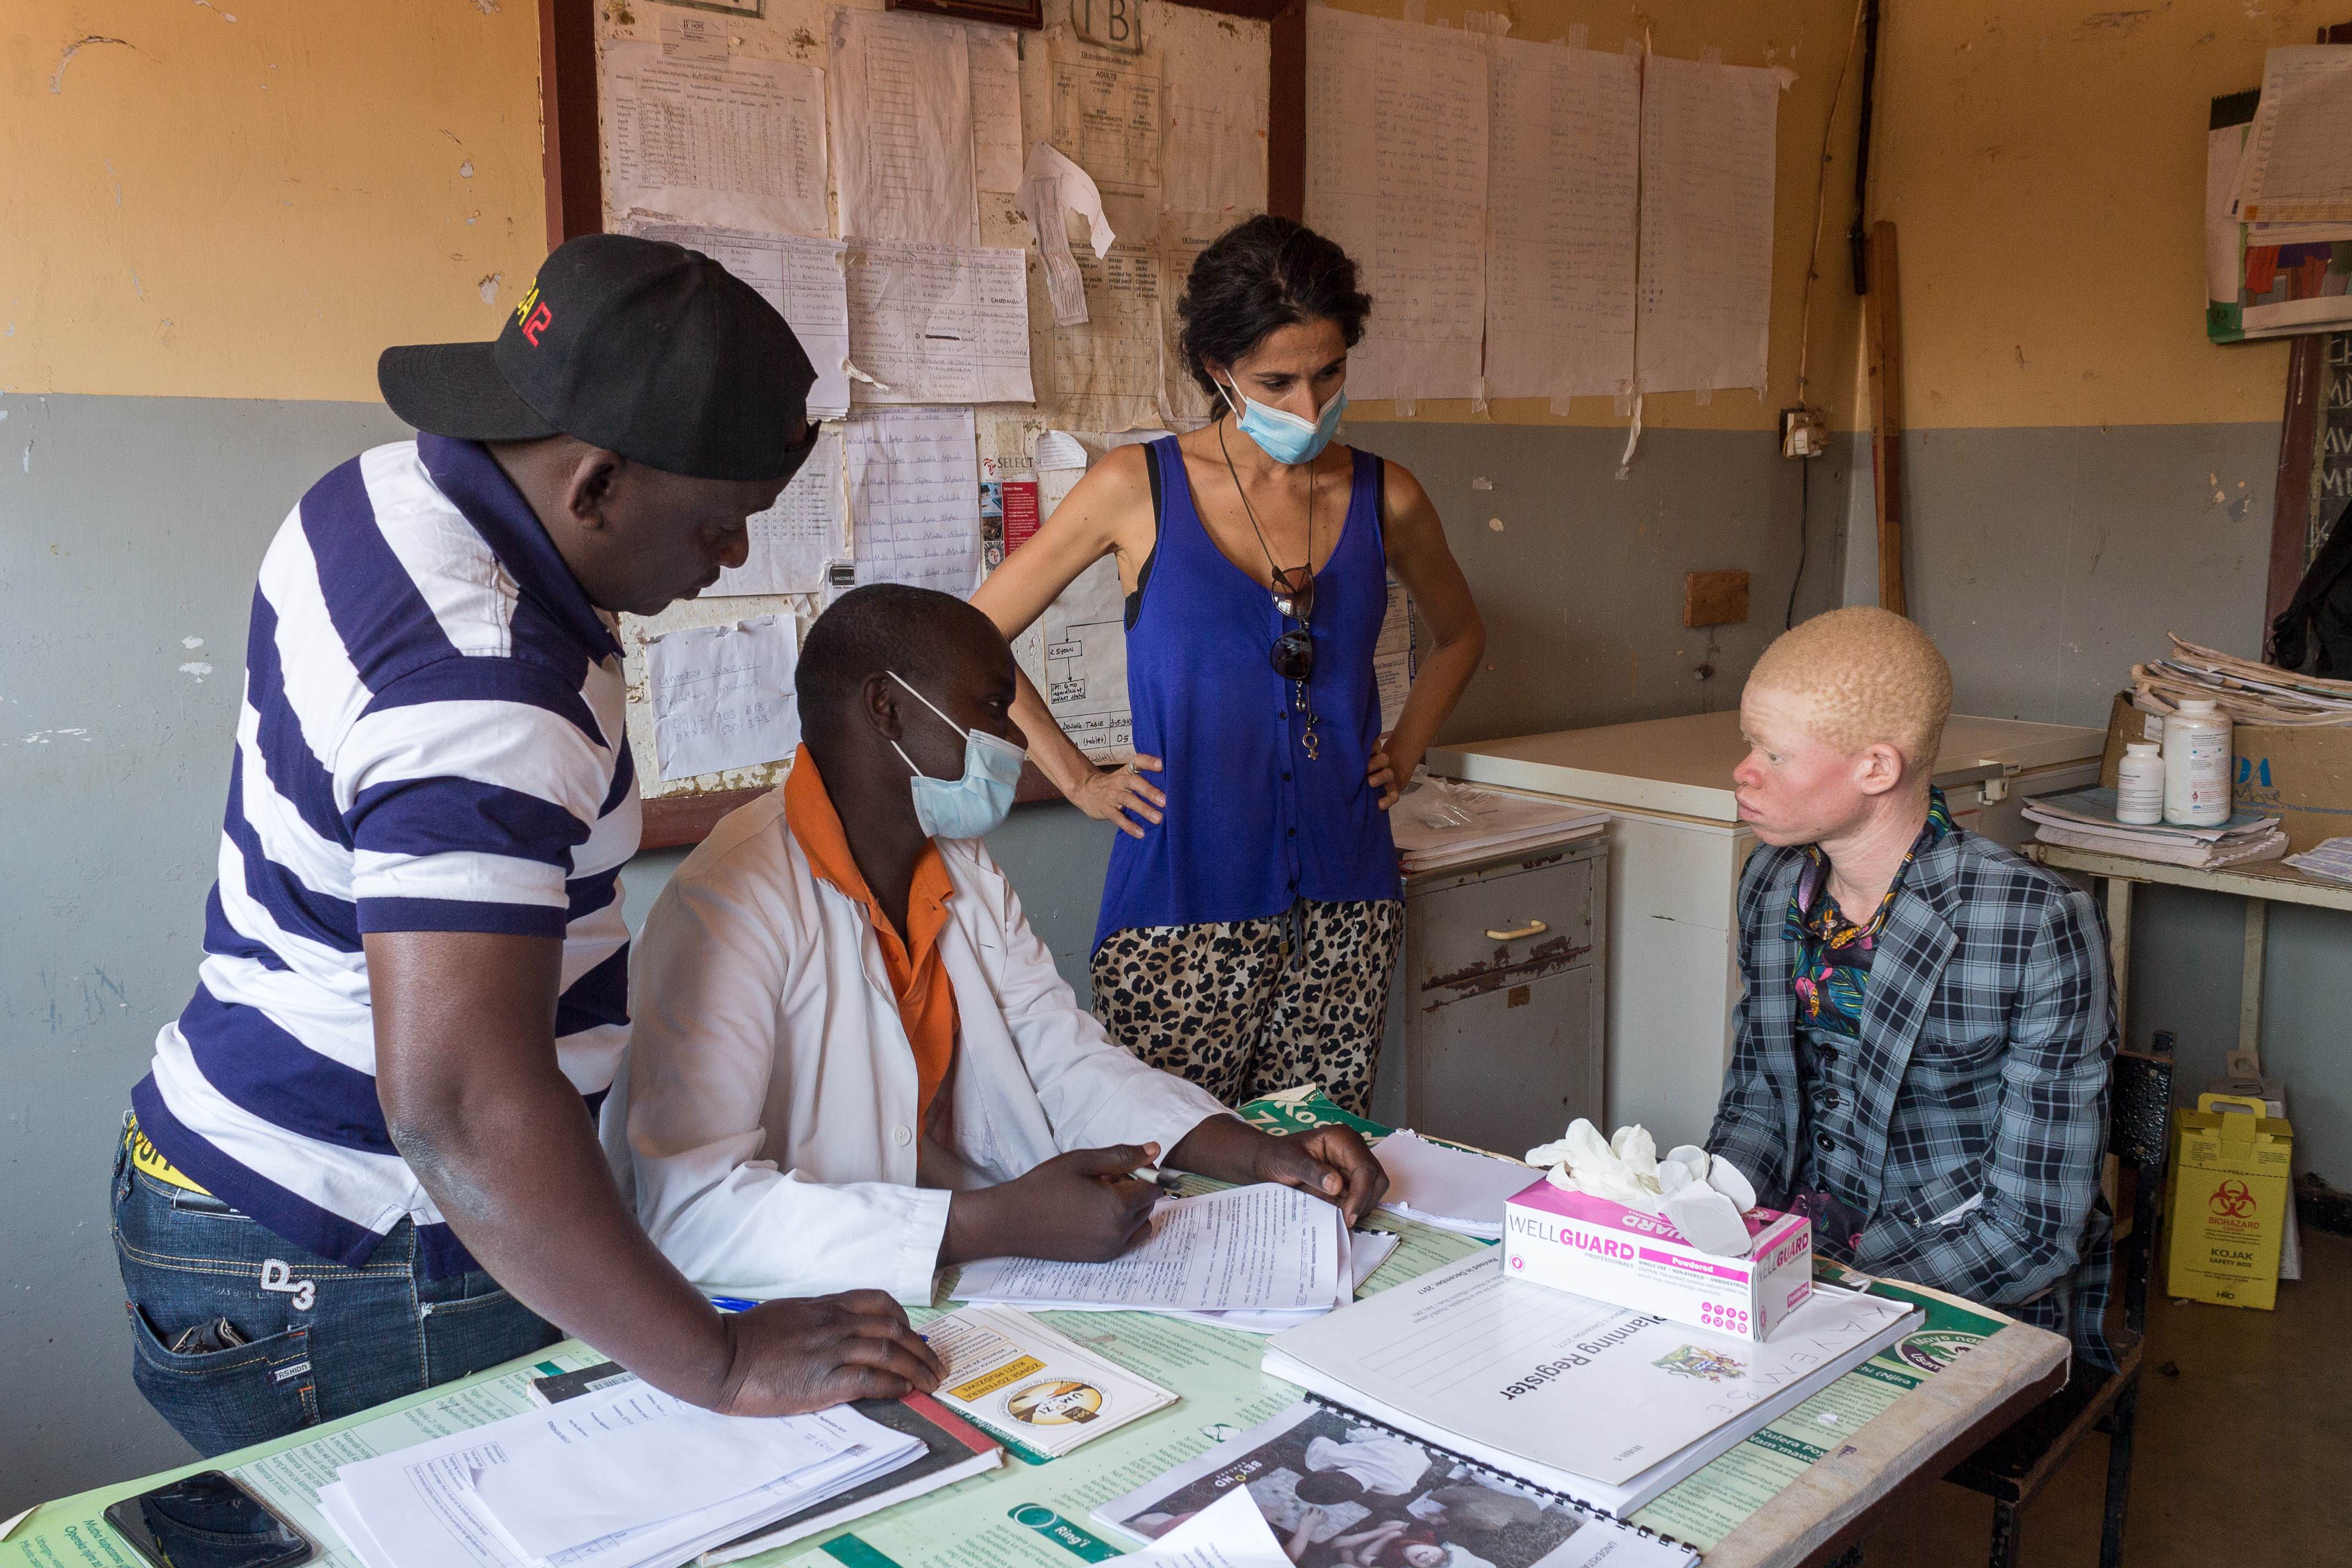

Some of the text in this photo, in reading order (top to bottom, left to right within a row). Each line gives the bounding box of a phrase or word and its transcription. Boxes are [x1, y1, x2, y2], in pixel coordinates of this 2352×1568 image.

[1096, 72, 1117, 80] ADULTS
[997, 456, 1033, 470] SELECT
[1063, 721, 1104, 731] DOSING TABLE
[1083, 733, 1107, 745] (tablet)
[2208, 1217, 2260, 1230] BIOHAZARD
[1510, 1214, 1635, 1261] WELLGUARD
[1585, 1252, 1635, 1268] PROFESSIONALS
[2211, 1248, 2253, 1260] KOJAK
[1639, 1260, 1654, 1270] SINGLE
[1672, 1257, 1713, 1273] Powdered
[1434, 1268, 1467, 1287] December
[1667, 1273, 1684, 1283] product
[1706, 1283, 1722, 1292] natural
[1788, 1282, 1809, 1303] Powdered
[1004, 1360, 1026, 1375] KUTI
[1011, 1362, 1041, 1378] ZONSE
[1498, 1354, 1591, 1402] Register
[1761, 1427, 1800, 1449] Kulera
[1214, 1460, 1263, 1488] BEYOND
[83, 1519, 103, 1540] Mutha
[1054, 1525, 1092, 1549] Ring'i
[1585, 1541, 1619, 1568] UNDERSTA
